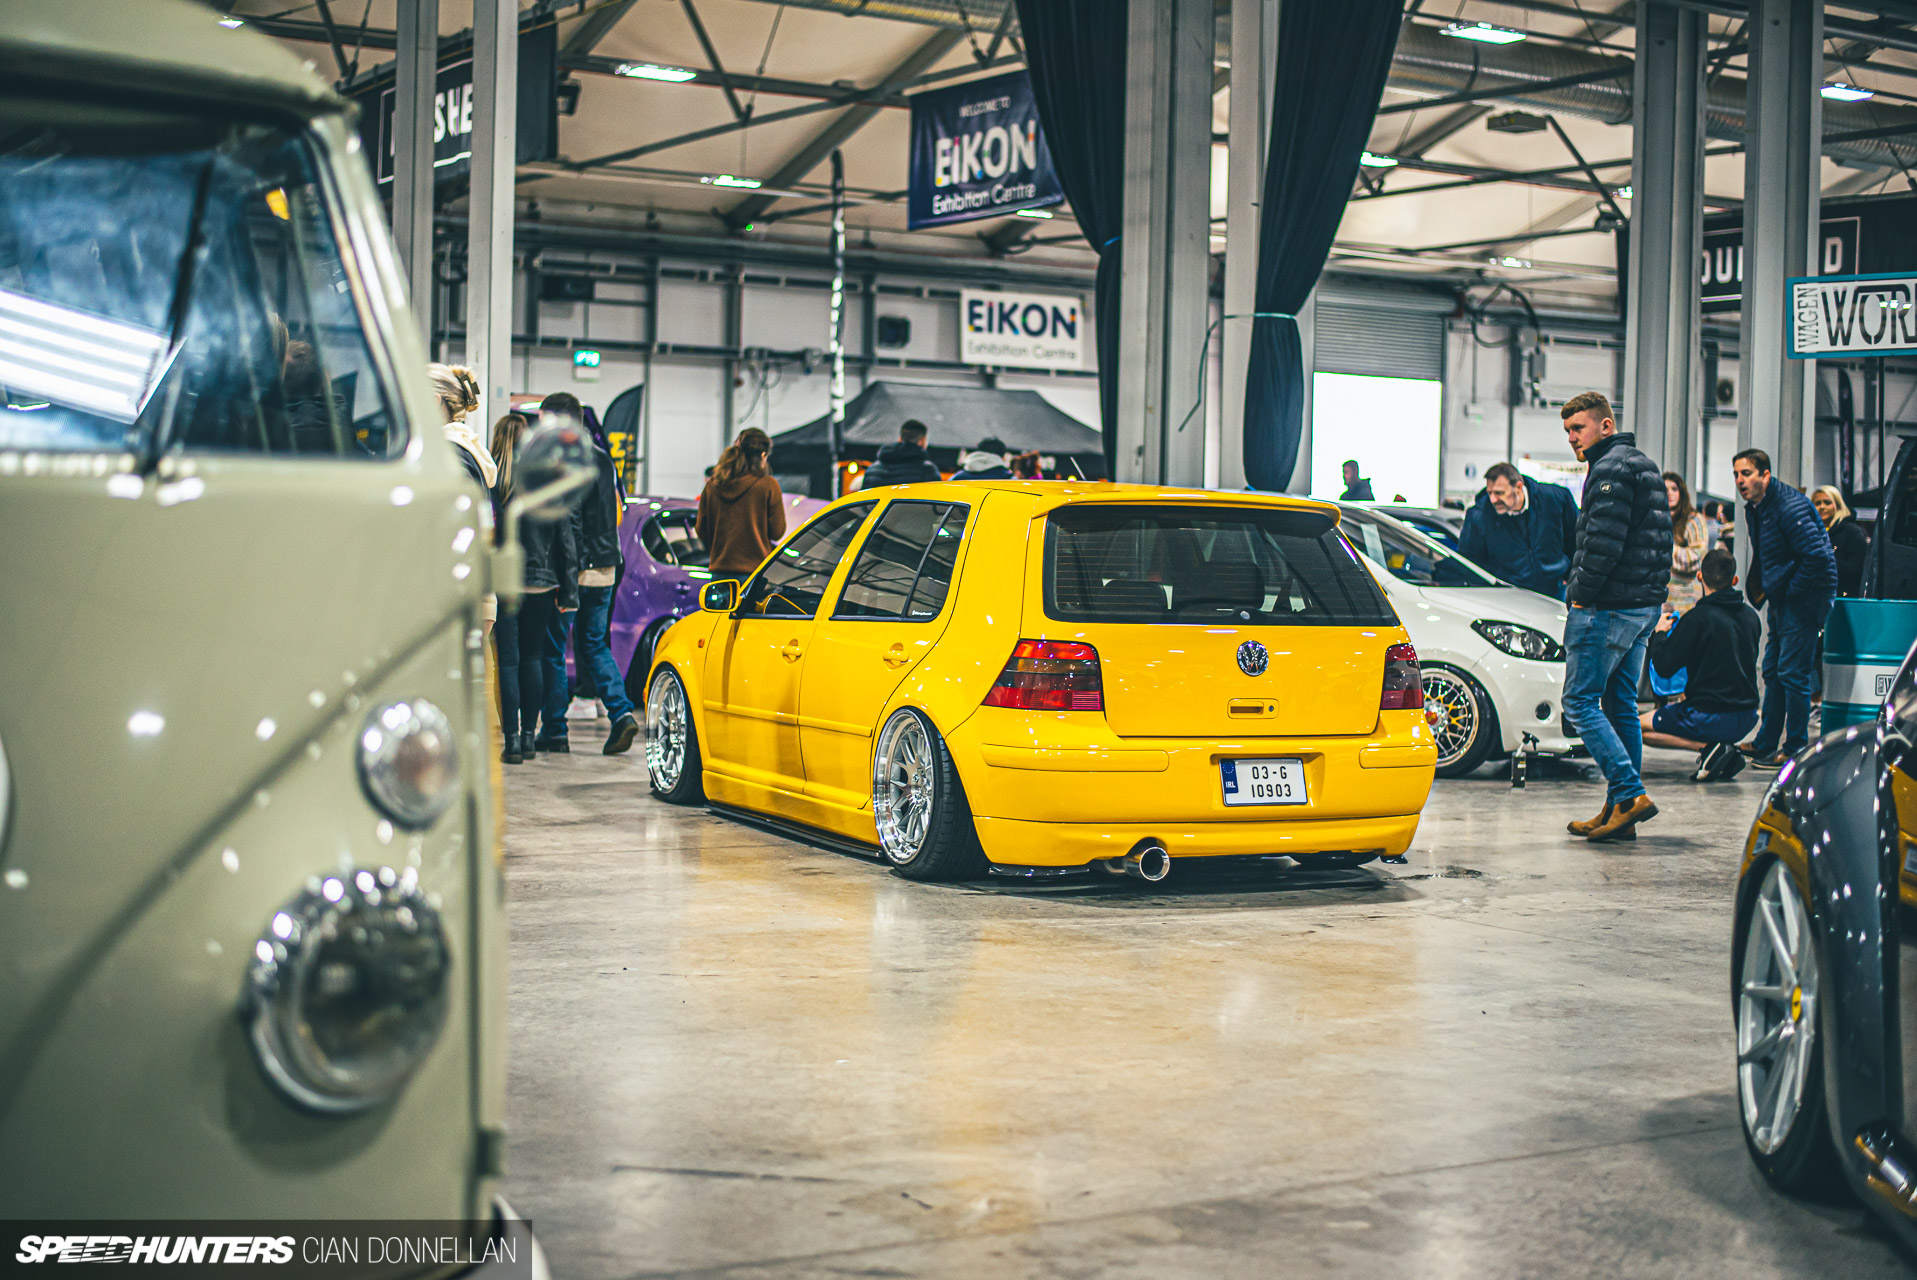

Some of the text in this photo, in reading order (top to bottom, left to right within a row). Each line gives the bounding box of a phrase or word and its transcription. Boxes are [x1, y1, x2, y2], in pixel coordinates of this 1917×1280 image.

[935, 119, 1036, 187] EIKON
[932, 183, 1036, 215] Exhibition Centre
[968, 299, 1076, 339] EIKON
[1797, 283, 1917, 348] WAGEN WOR
[1032, 344, 1077, 360] Centre
[1225, 781, 1236, 789] IRL
[1251, 784, 1291, 798] 10903
